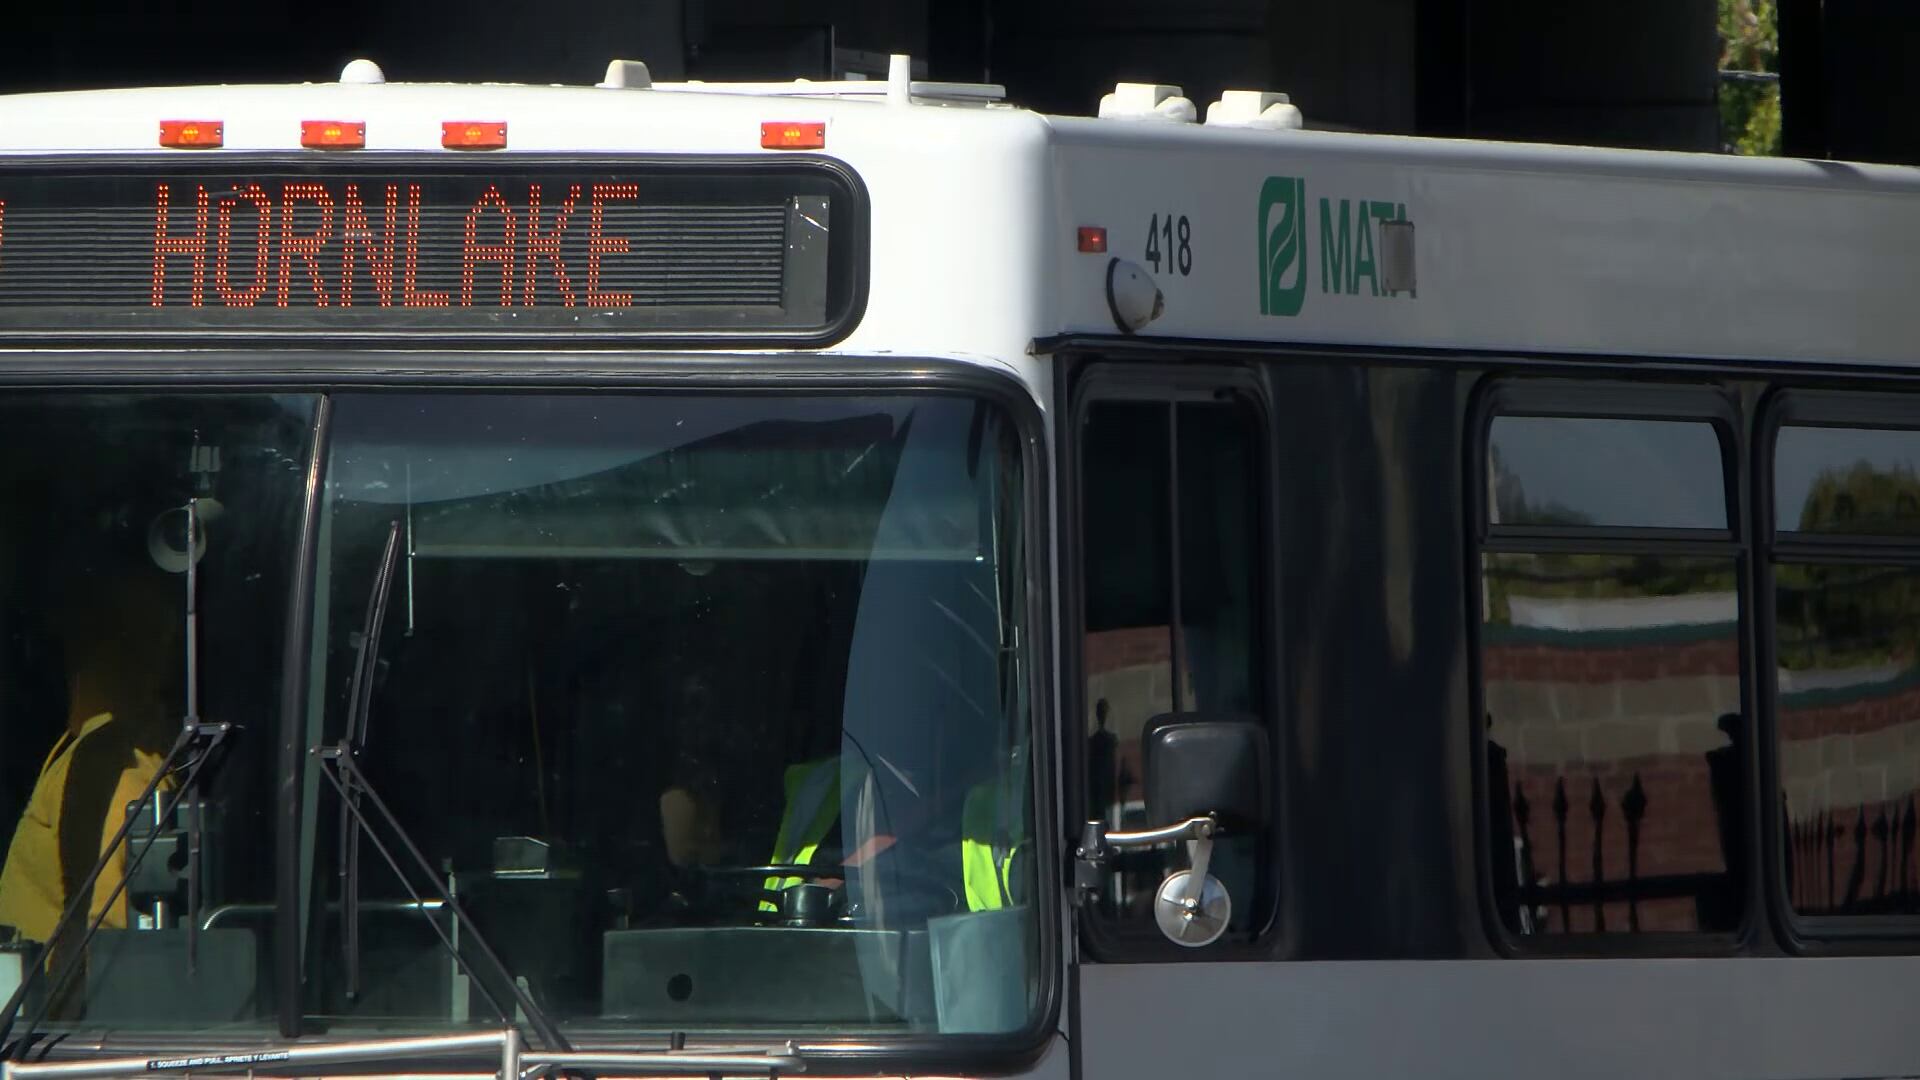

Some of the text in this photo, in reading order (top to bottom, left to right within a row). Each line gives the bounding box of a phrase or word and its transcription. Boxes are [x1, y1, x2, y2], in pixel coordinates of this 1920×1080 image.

[151, 184, 639, 308] HORNLAKE
[1145, 213, 1192, 277] 418
[1319, 197, 1417, 299] MAT
[157, 1060, 188, 1069] SQUEEZE
